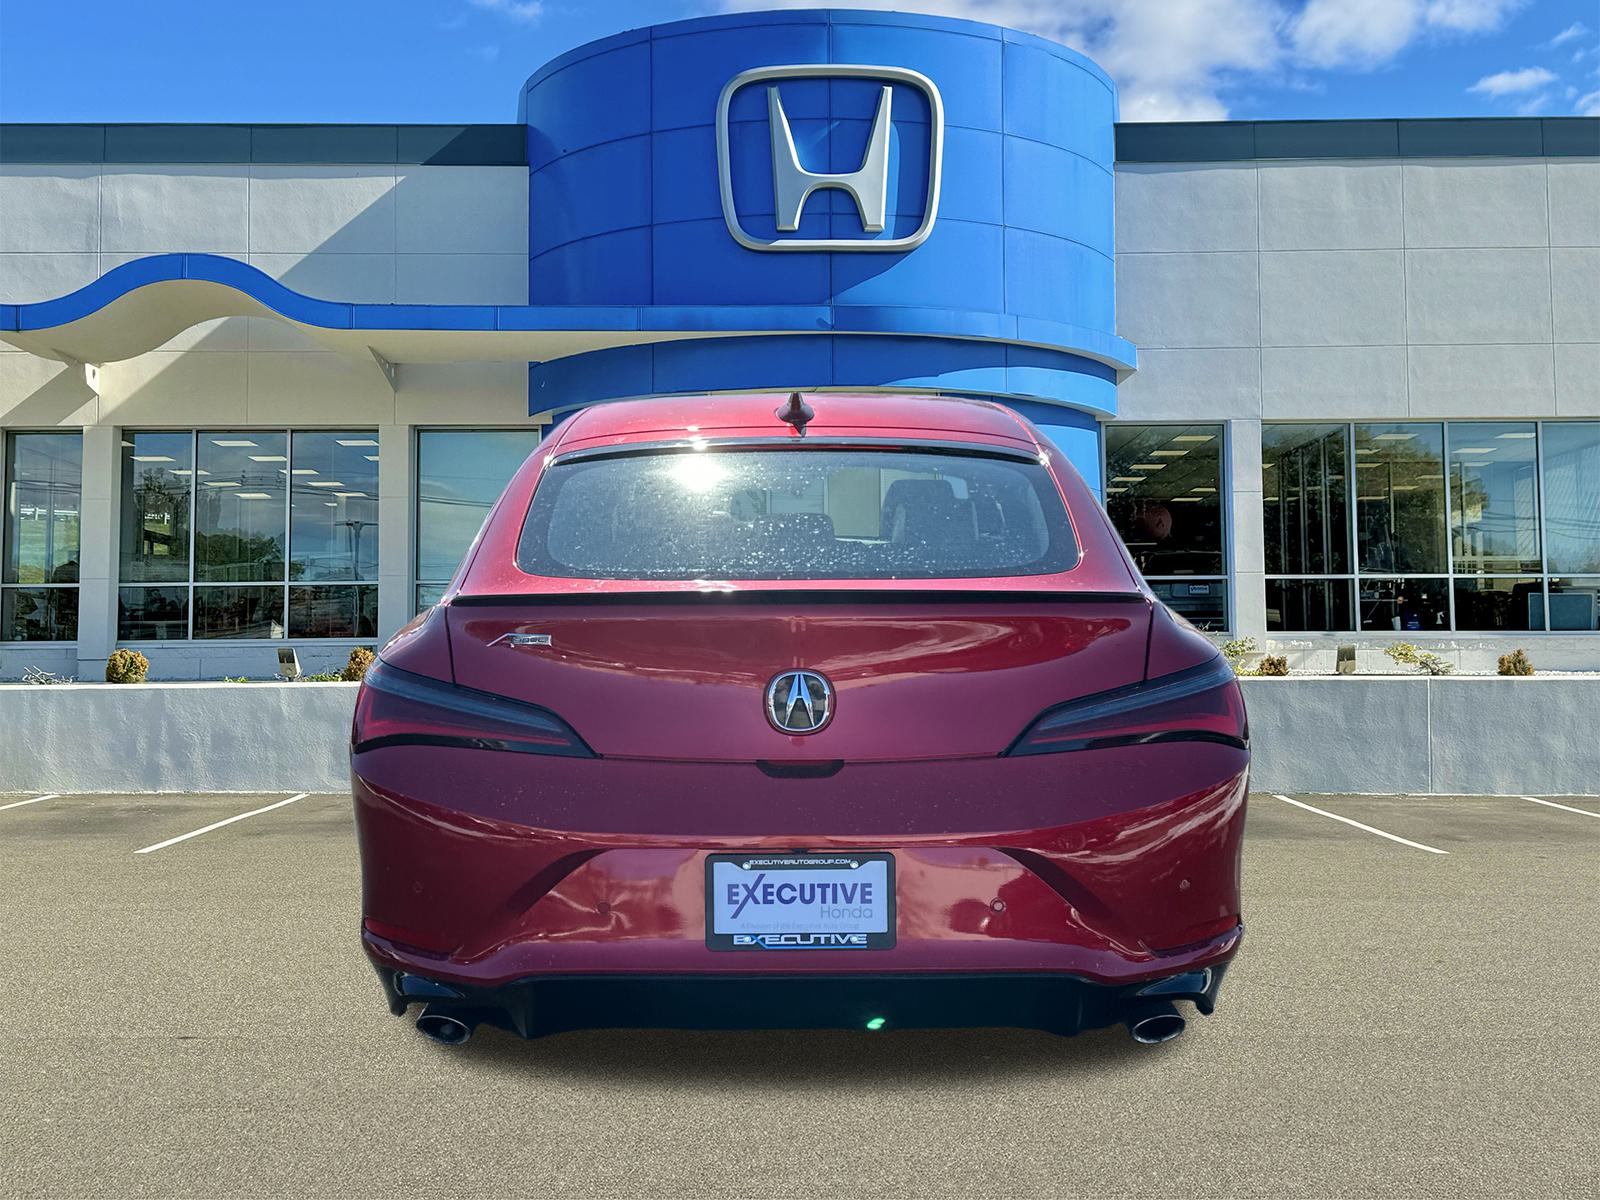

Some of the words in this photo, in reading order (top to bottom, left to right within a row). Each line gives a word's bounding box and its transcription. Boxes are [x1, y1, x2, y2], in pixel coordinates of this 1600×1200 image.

[727, 873, 873, 919] EXECUTIVE
[821, 905, 873, 919] Honda
[733, 934, 868, 947] EXECUTIVE
